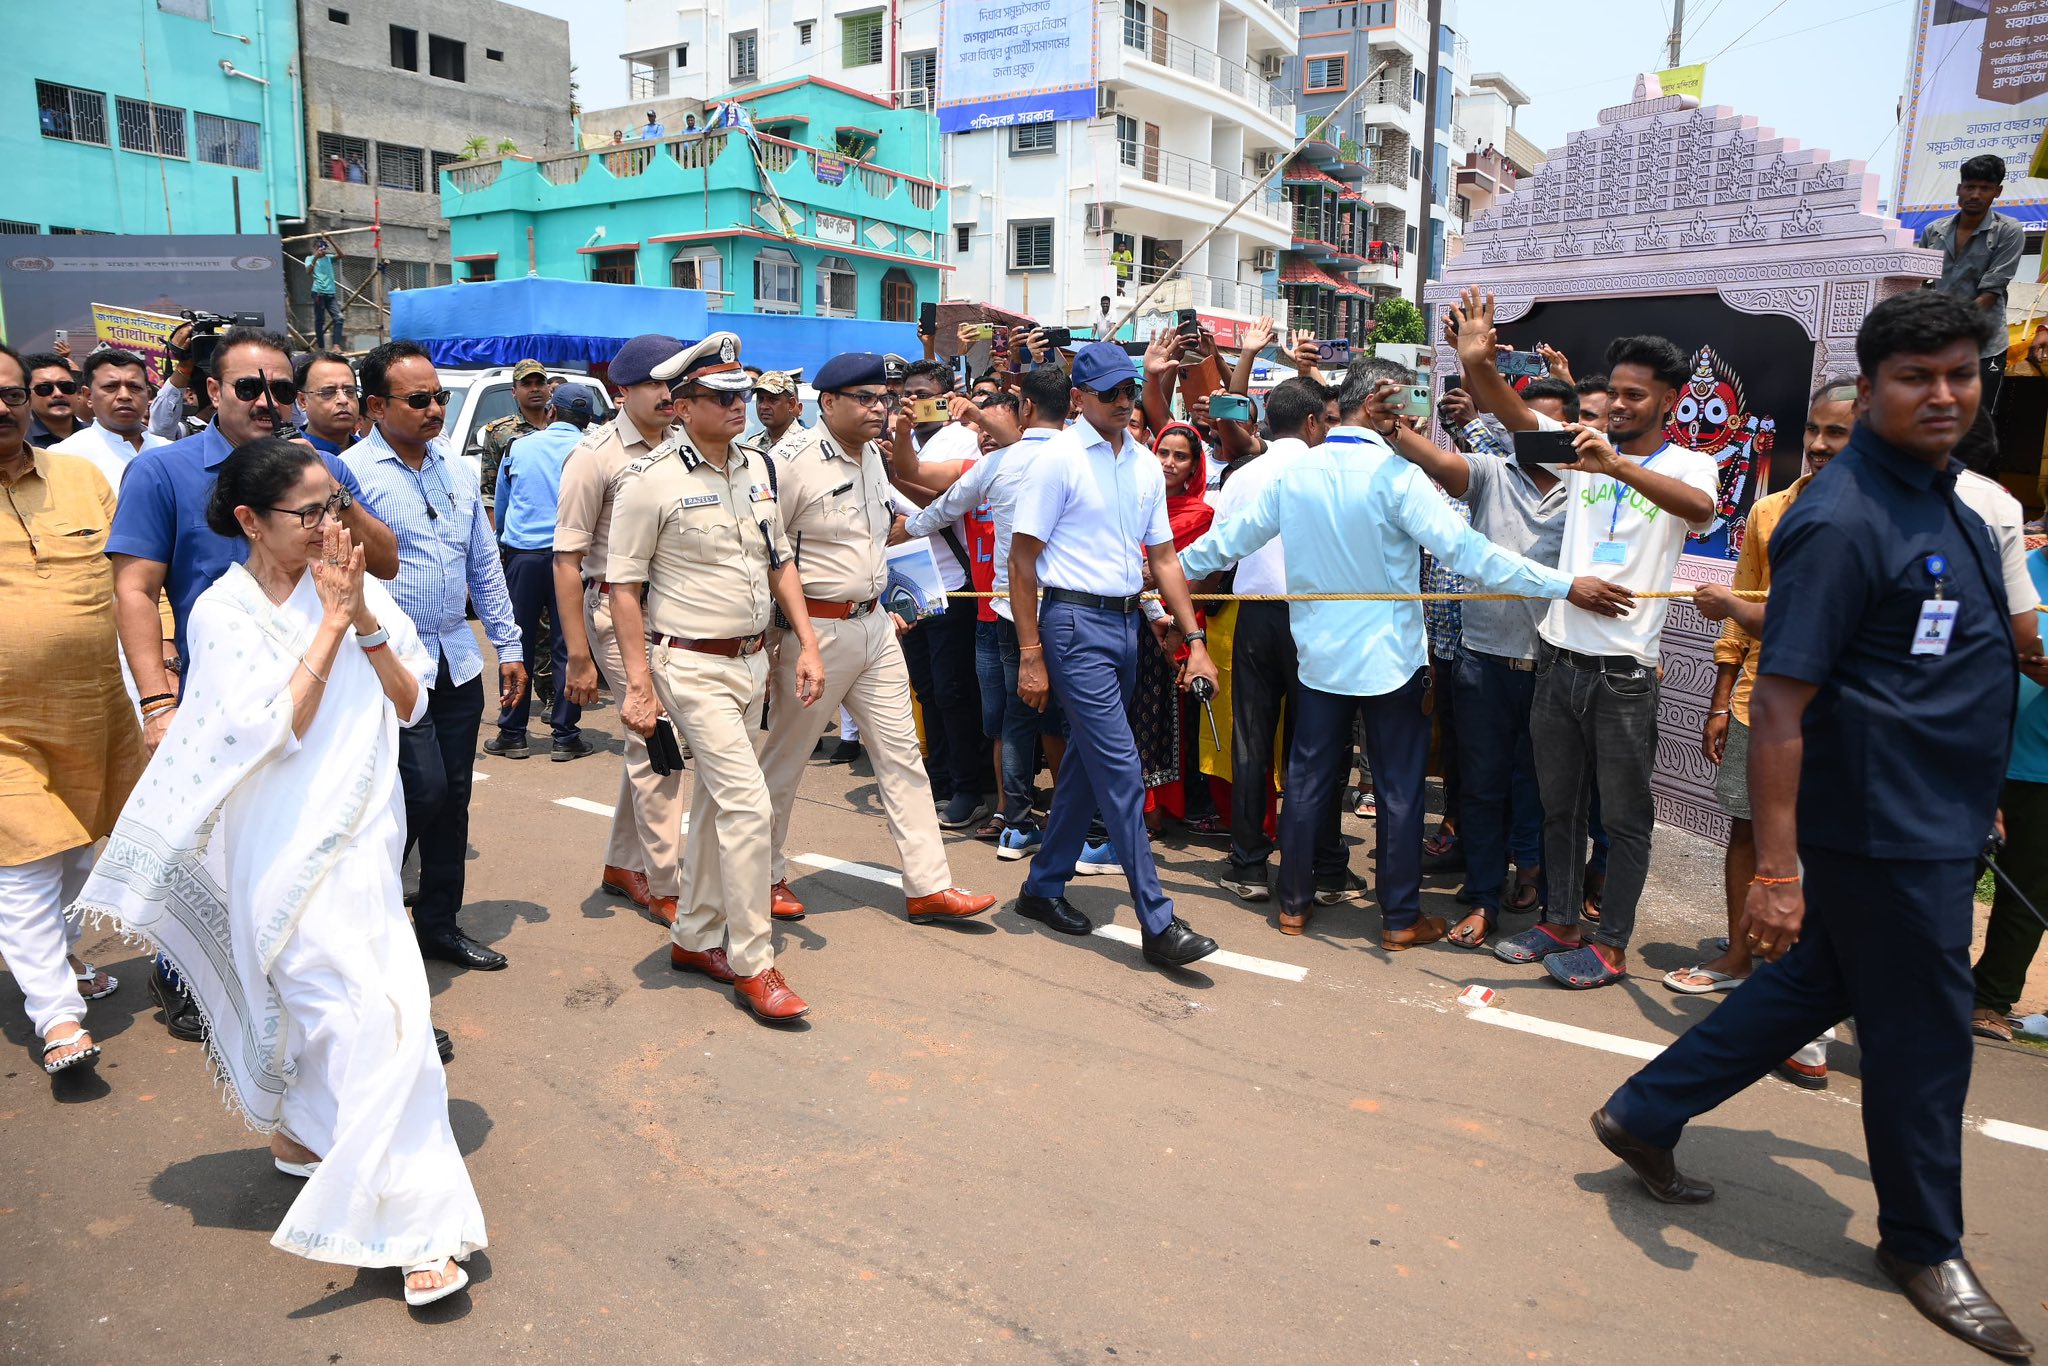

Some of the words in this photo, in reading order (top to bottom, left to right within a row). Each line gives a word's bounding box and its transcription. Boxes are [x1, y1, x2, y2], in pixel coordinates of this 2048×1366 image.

[1995, 6, 2009, 14] ২৯
[963, 26, 1018, 43] জগন্নাথদেবের
[1020, 22, 1040, 36] নতুন
[1041, 17, 1067, 31] নিবাস
[959, 52, 977, 63] সারা
[978, 47, 1003, 62] বিশ্বের
[1031, 37, 1070, 53] সমাগমের
[1989, 40, 2003, 49] ৩০
[992, 65, 1012, 78] জন্য
[1013, 62, 1035, 78] প্রস্তুত
[1992, 70, 2046, 88] প্রাণপ্রতিষ্ঠা
[970, 113, 1015, 129] পশ্চিমবঙ্গ
[1018, 109, 1055, 123] সরকার
[1967, 122, 2002, 134] হাজার
[2004, 119, 2031, 131] বছর
[1926, 137, 1975, 155] সমুদ্রতীরে
[1977, 137, 2000, 148] এক
[2001, 134, 2029, 149] নতুন
[1938, 161, 1958, 170] সারা
